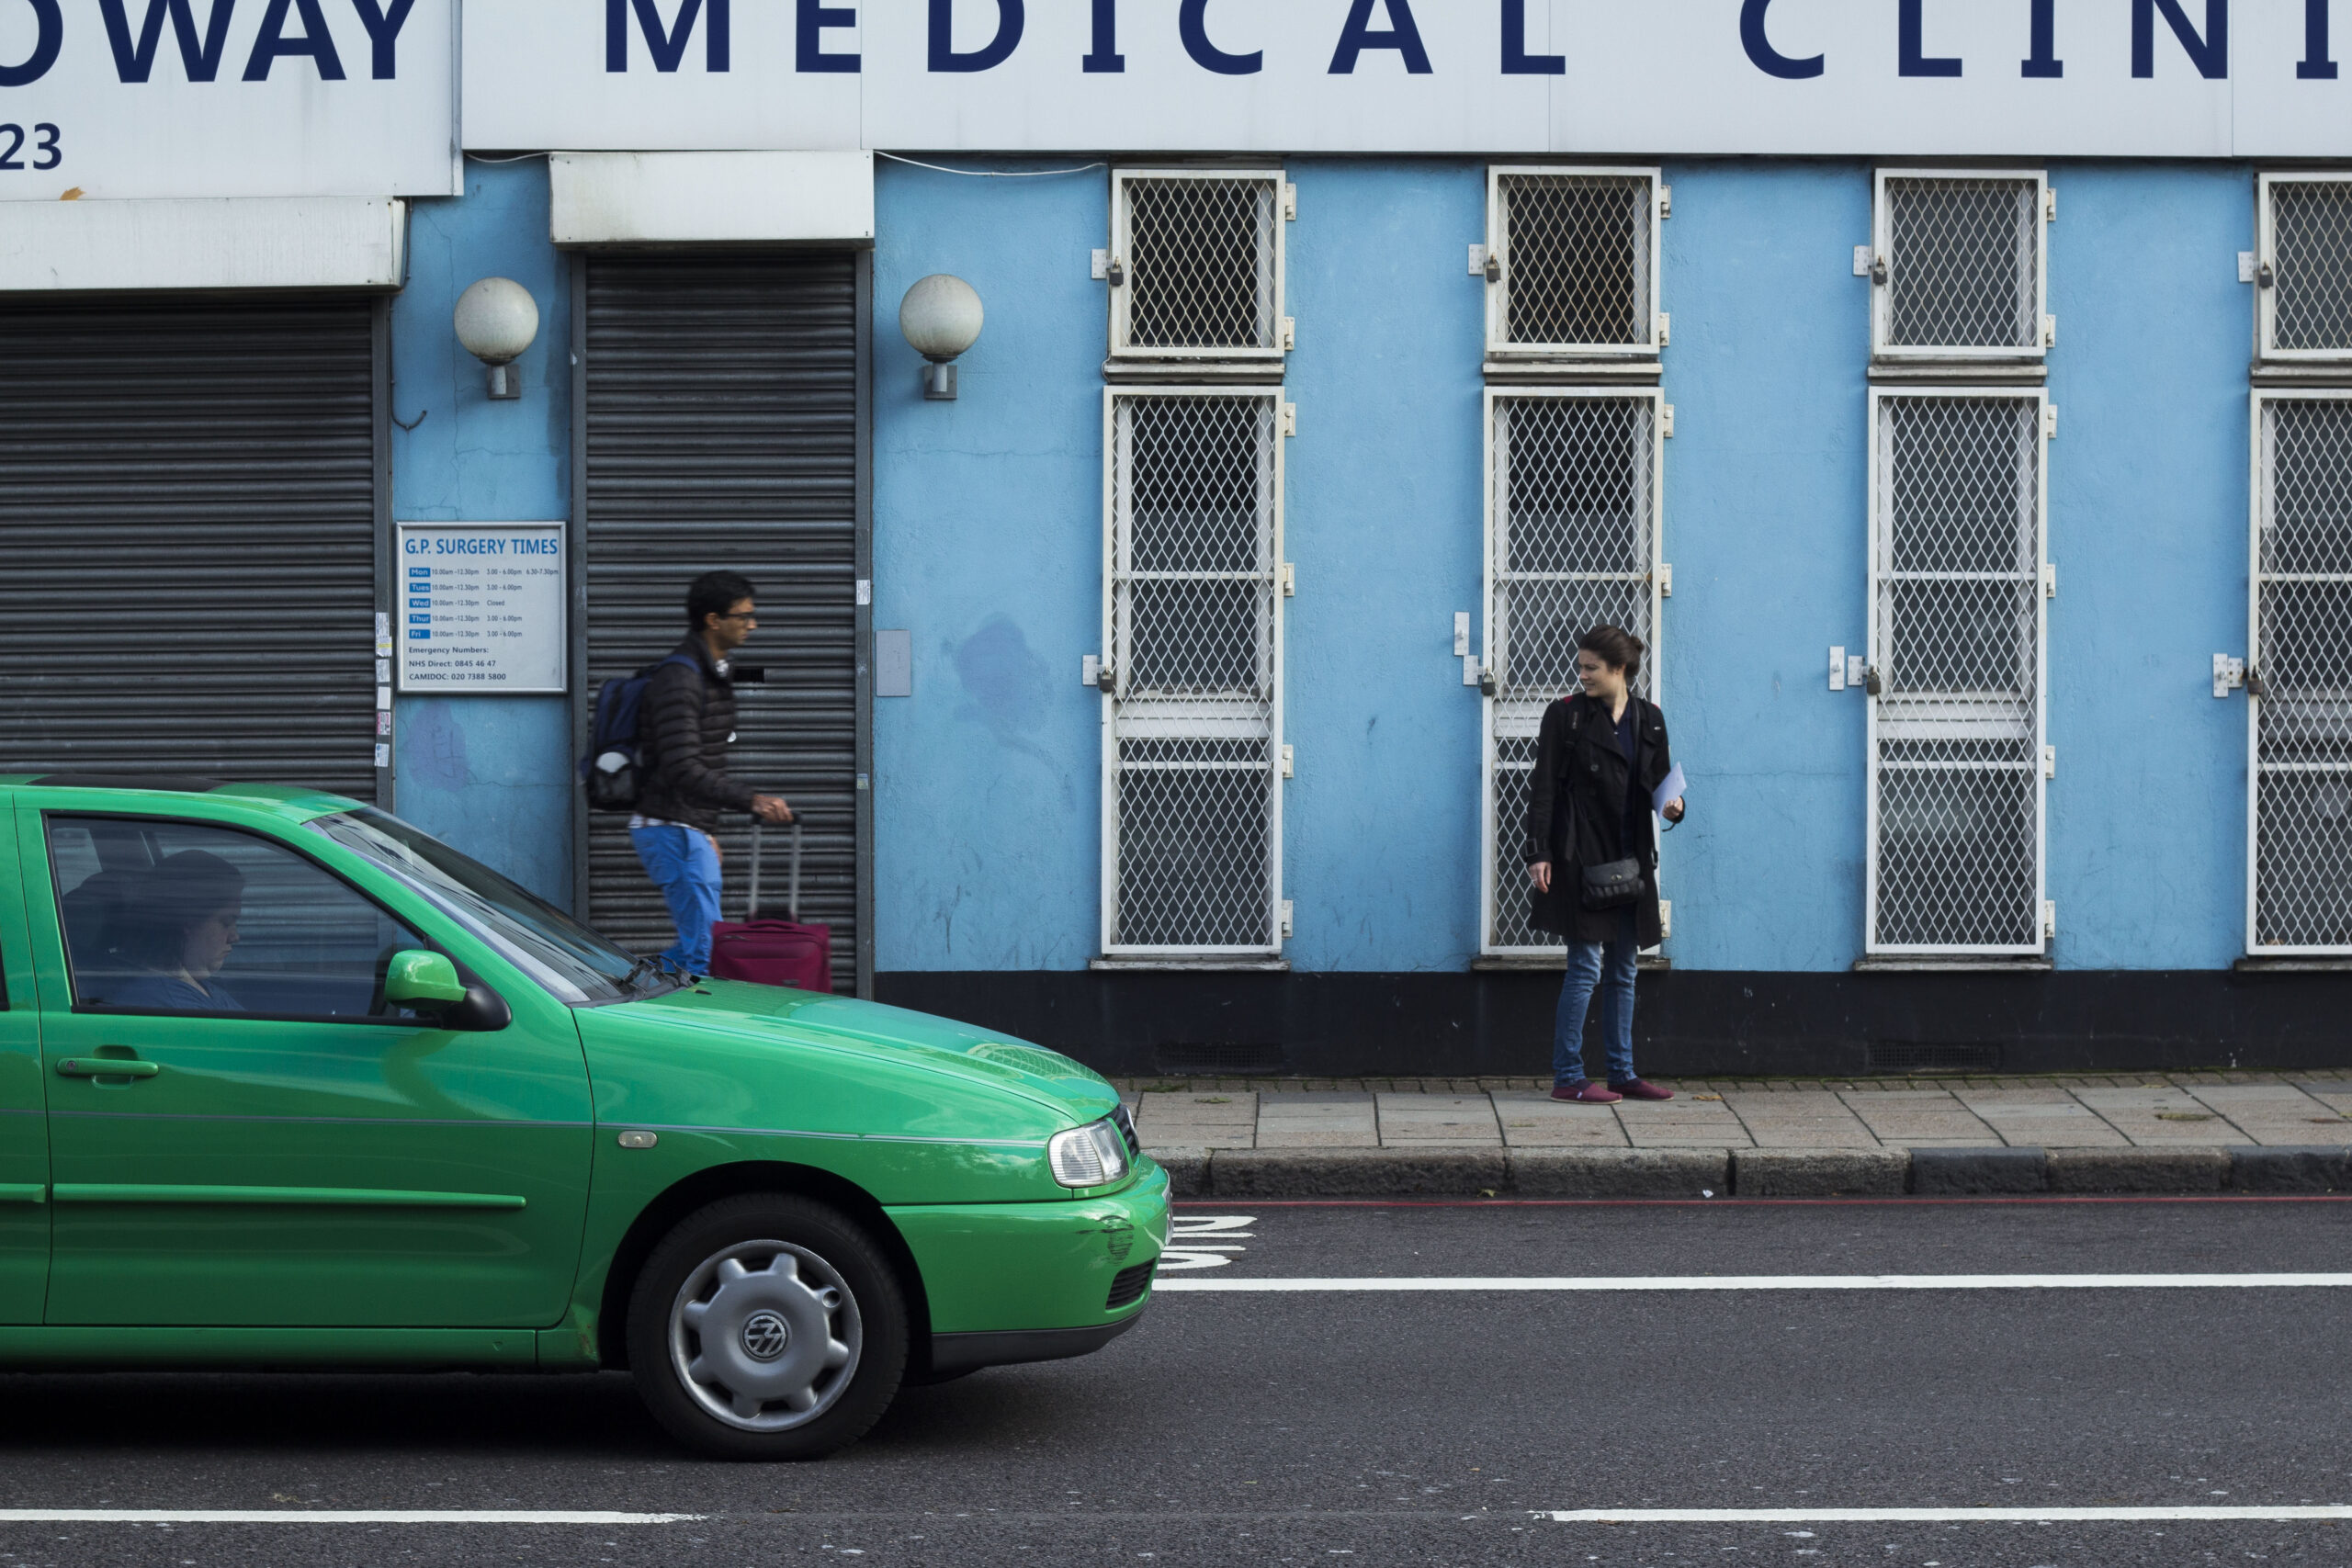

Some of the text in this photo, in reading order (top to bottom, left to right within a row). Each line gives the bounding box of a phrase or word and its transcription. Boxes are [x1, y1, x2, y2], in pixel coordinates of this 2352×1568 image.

[605, 0, 2338, 80] MEDICAL CLINI
[0, 122, 62, 170] 23
[405, 538, 558, 554] G.P. SURGERY TIMES
